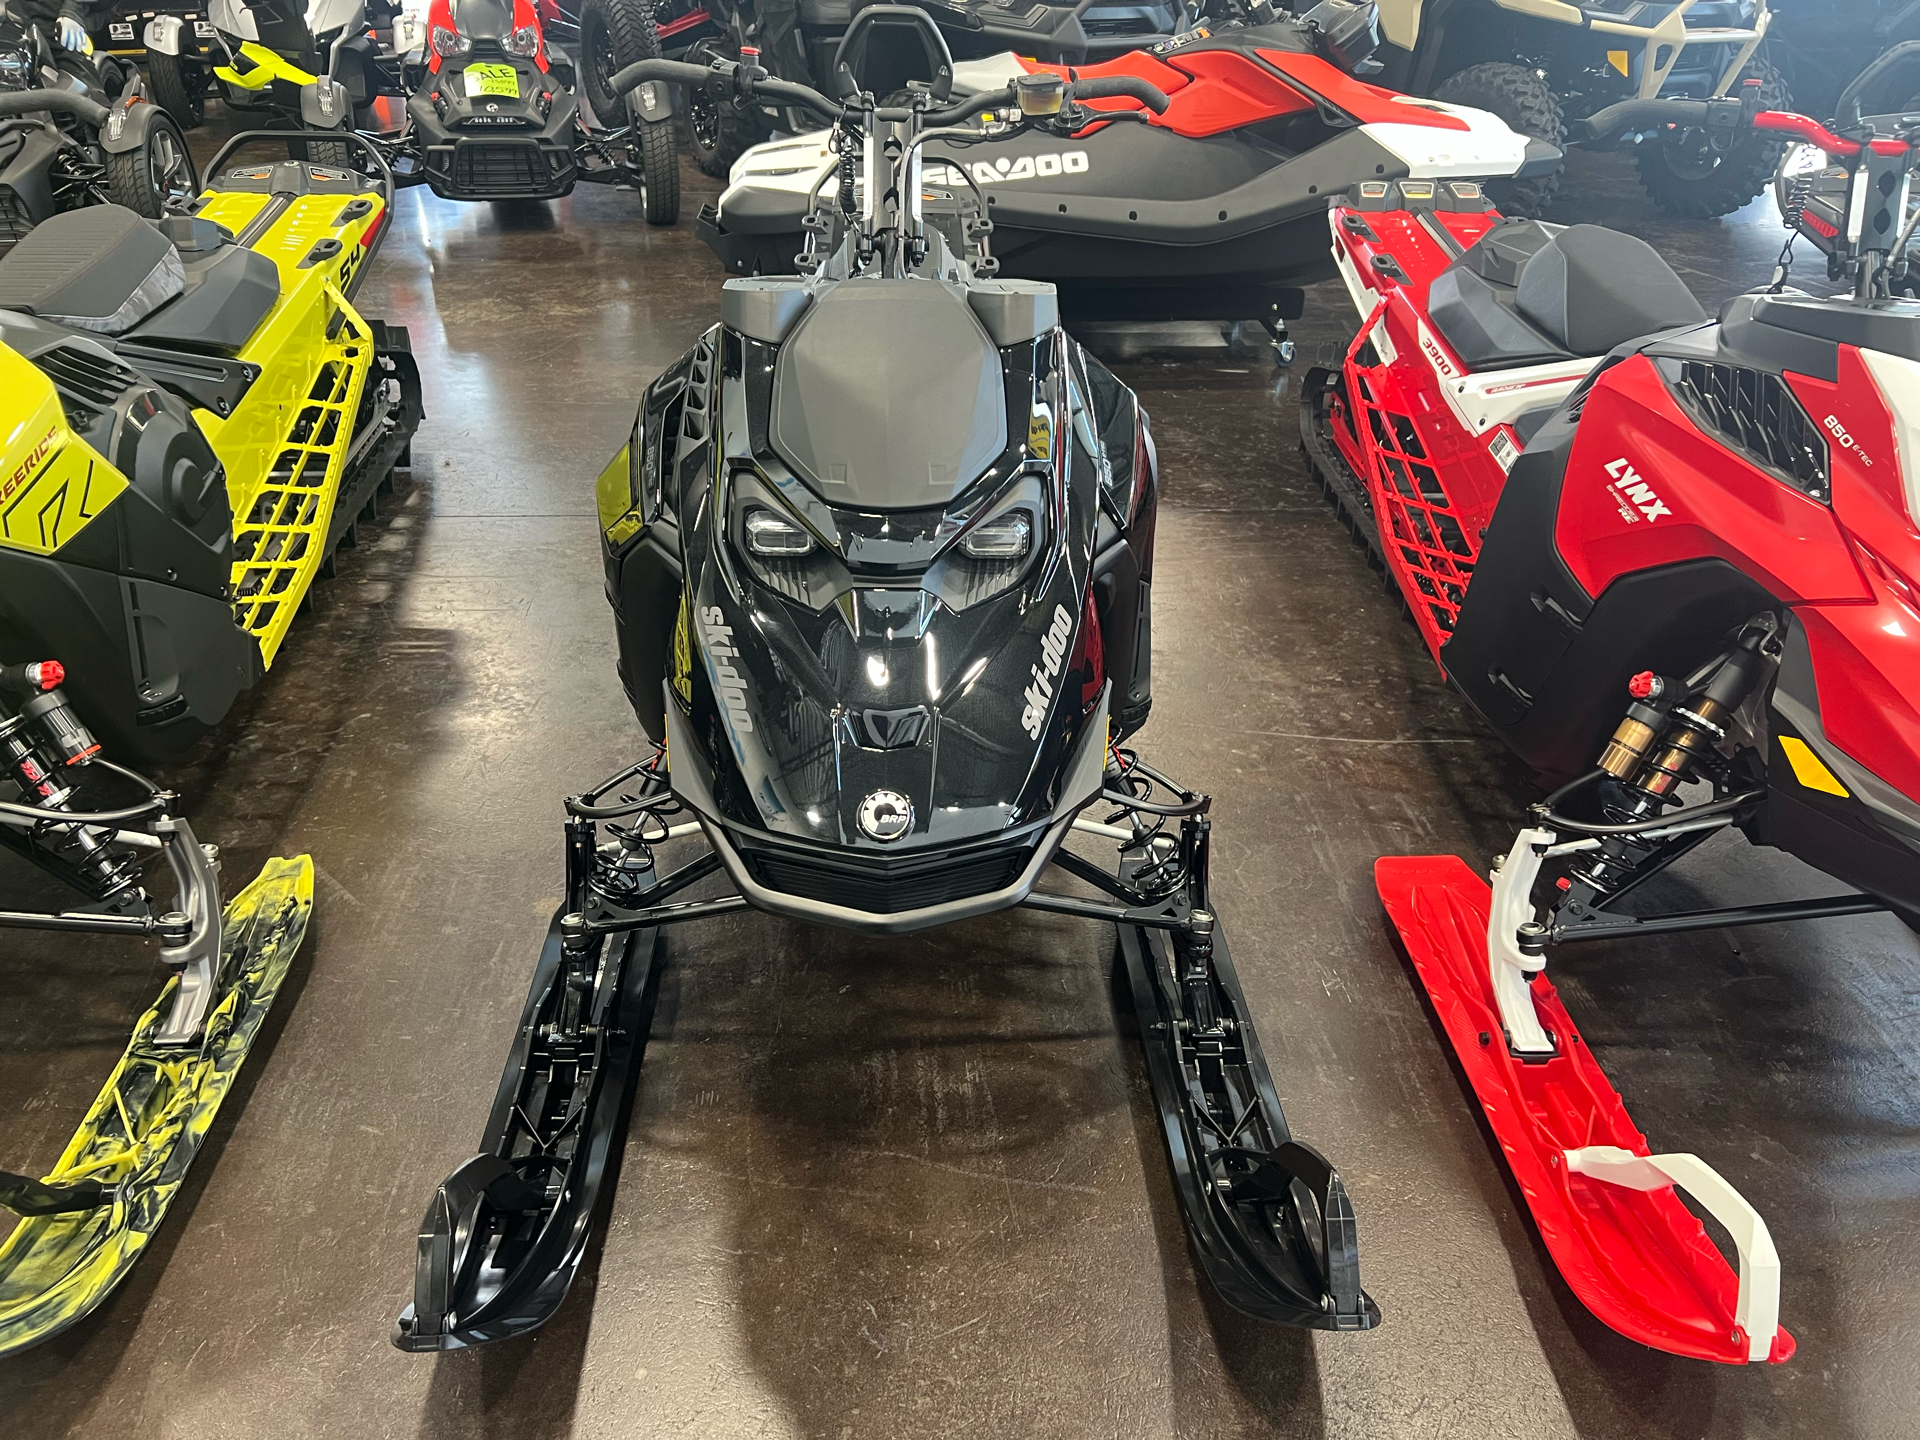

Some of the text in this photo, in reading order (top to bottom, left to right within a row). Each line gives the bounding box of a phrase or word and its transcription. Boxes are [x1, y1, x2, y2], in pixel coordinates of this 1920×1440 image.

[466, 68, 514, 80] SALE
[1422, 337, 1452, 376] 3900
[646, 445, 655, 471] 850
[1823, 414, 1873, 467] 850 E-TEC
[1102, 458, 1114, 489] 850
[1603, 457, 1673, 523] LYNX
[701, 605, 753, 734] ski-doo
[1021, 603, 1073, 741] ski-doo
[880, 814, 908, 824] BRP
